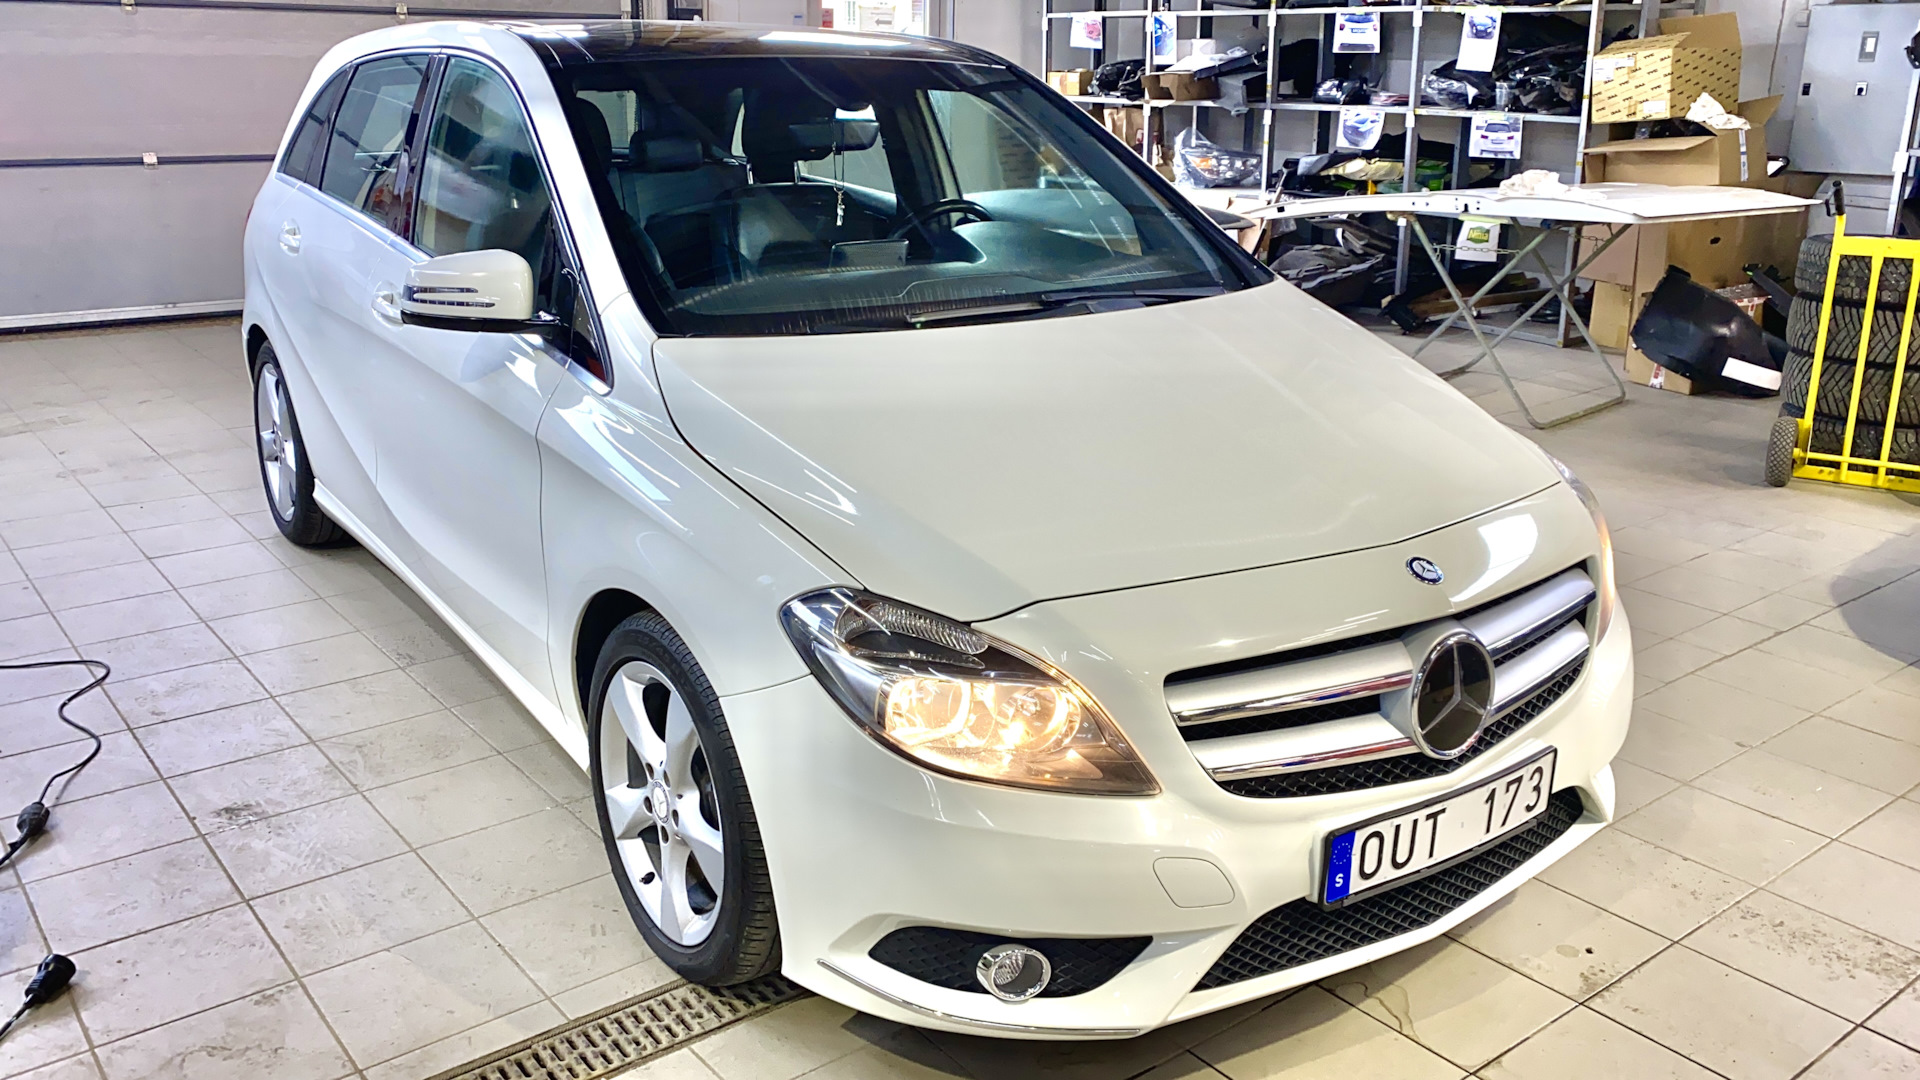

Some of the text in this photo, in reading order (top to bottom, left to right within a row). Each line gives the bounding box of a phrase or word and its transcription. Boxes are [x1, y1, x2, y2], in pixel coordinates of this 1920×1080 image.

[1358, 765, 1544, 881] OUT 173
[1335, 873, 1344, 888] S
